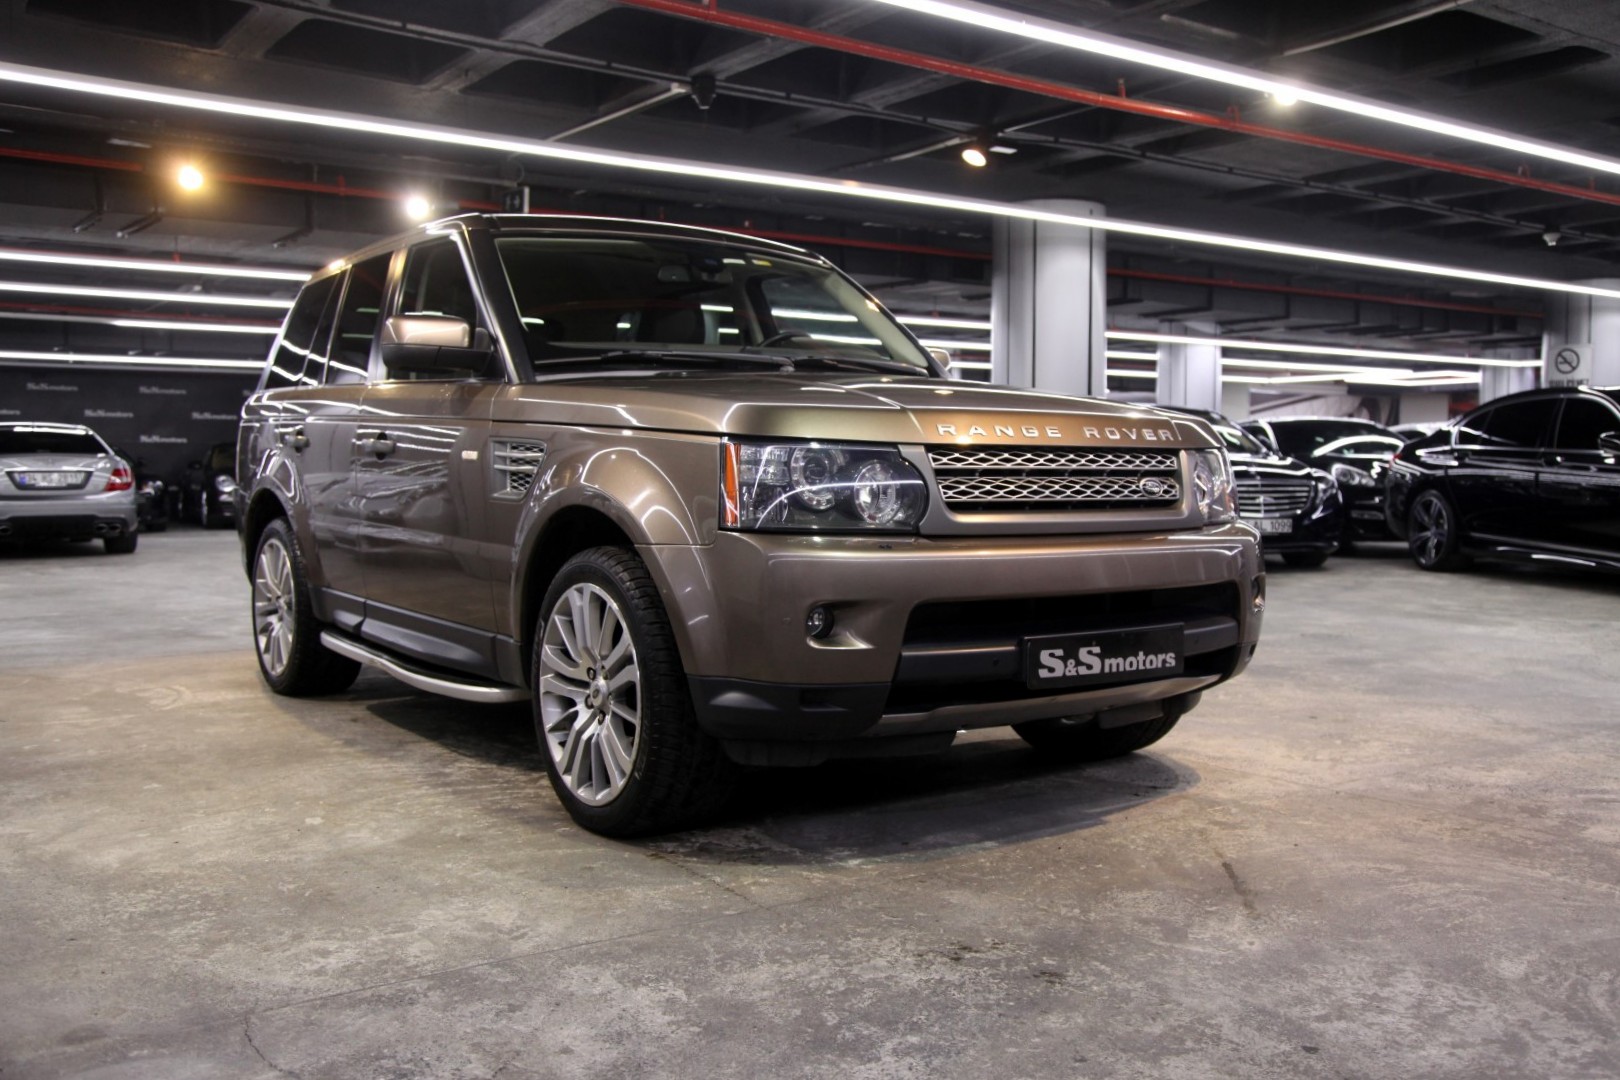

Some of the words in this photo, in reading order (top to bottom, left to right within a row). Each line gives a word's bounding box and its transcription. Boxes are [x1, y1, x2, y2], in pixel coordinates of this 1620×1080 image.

[936, 423, 1062, 438] RANGE
[1083, 426, 1174, 441] ROVER
[1038, 646, 1102, 678] S&S
[1104, 651, 1176, 673] motors
